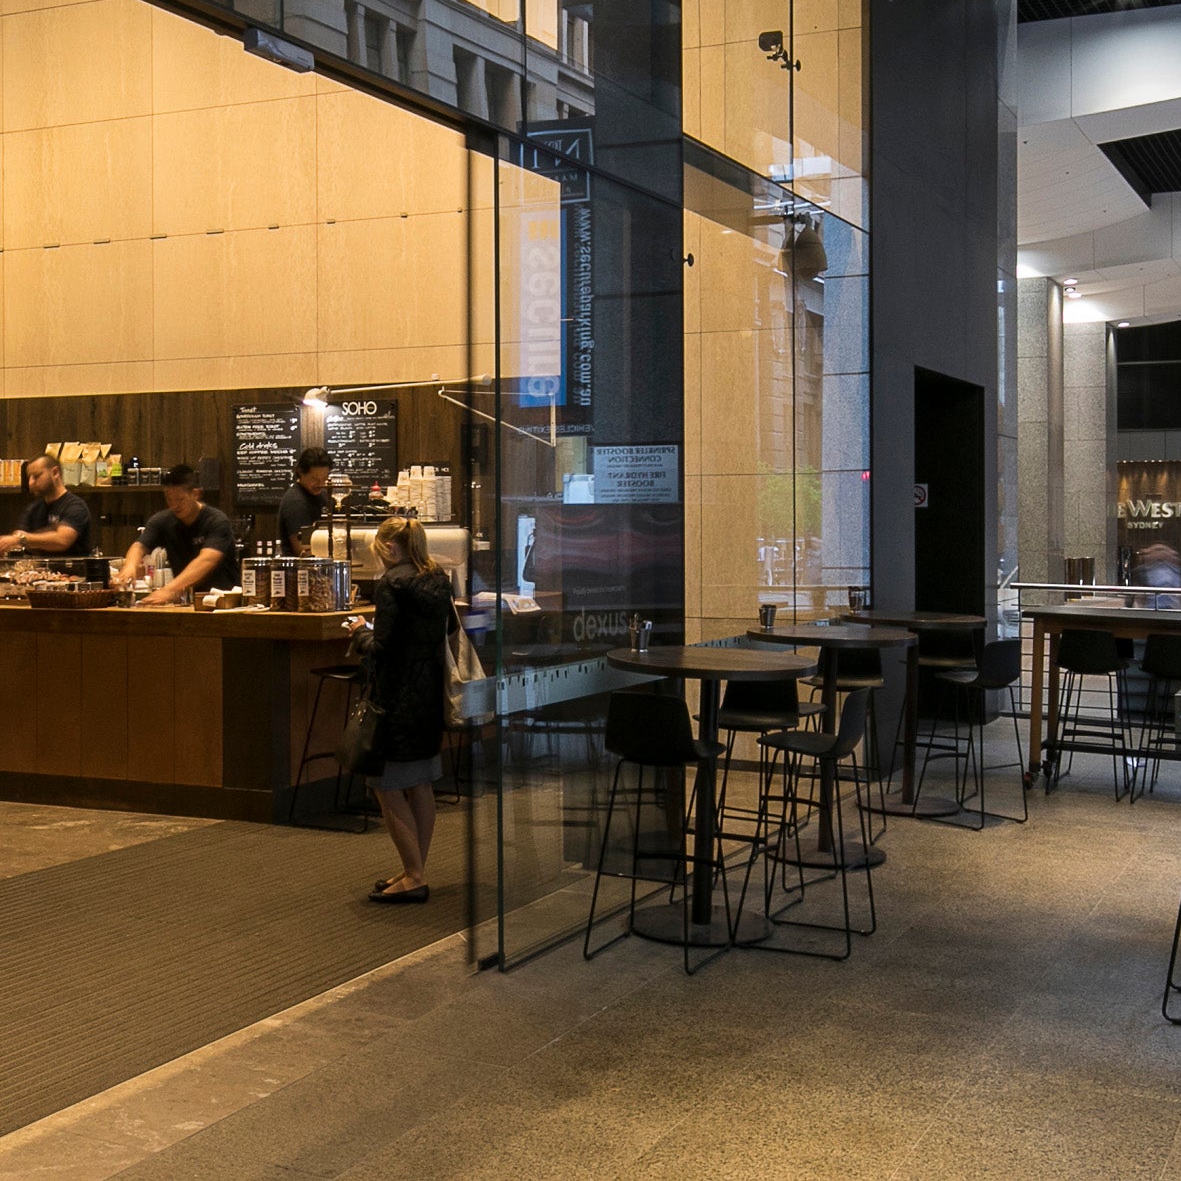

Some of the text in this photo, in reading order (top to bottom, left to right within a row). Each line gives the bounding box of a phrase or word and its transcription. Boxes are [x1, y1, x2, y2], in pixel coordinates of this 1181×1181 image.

[341, 401, 378, 416] SOHO
[1127, 521, 1164, 529] SYDNEY
[573, 605, 627, 642] dexus
